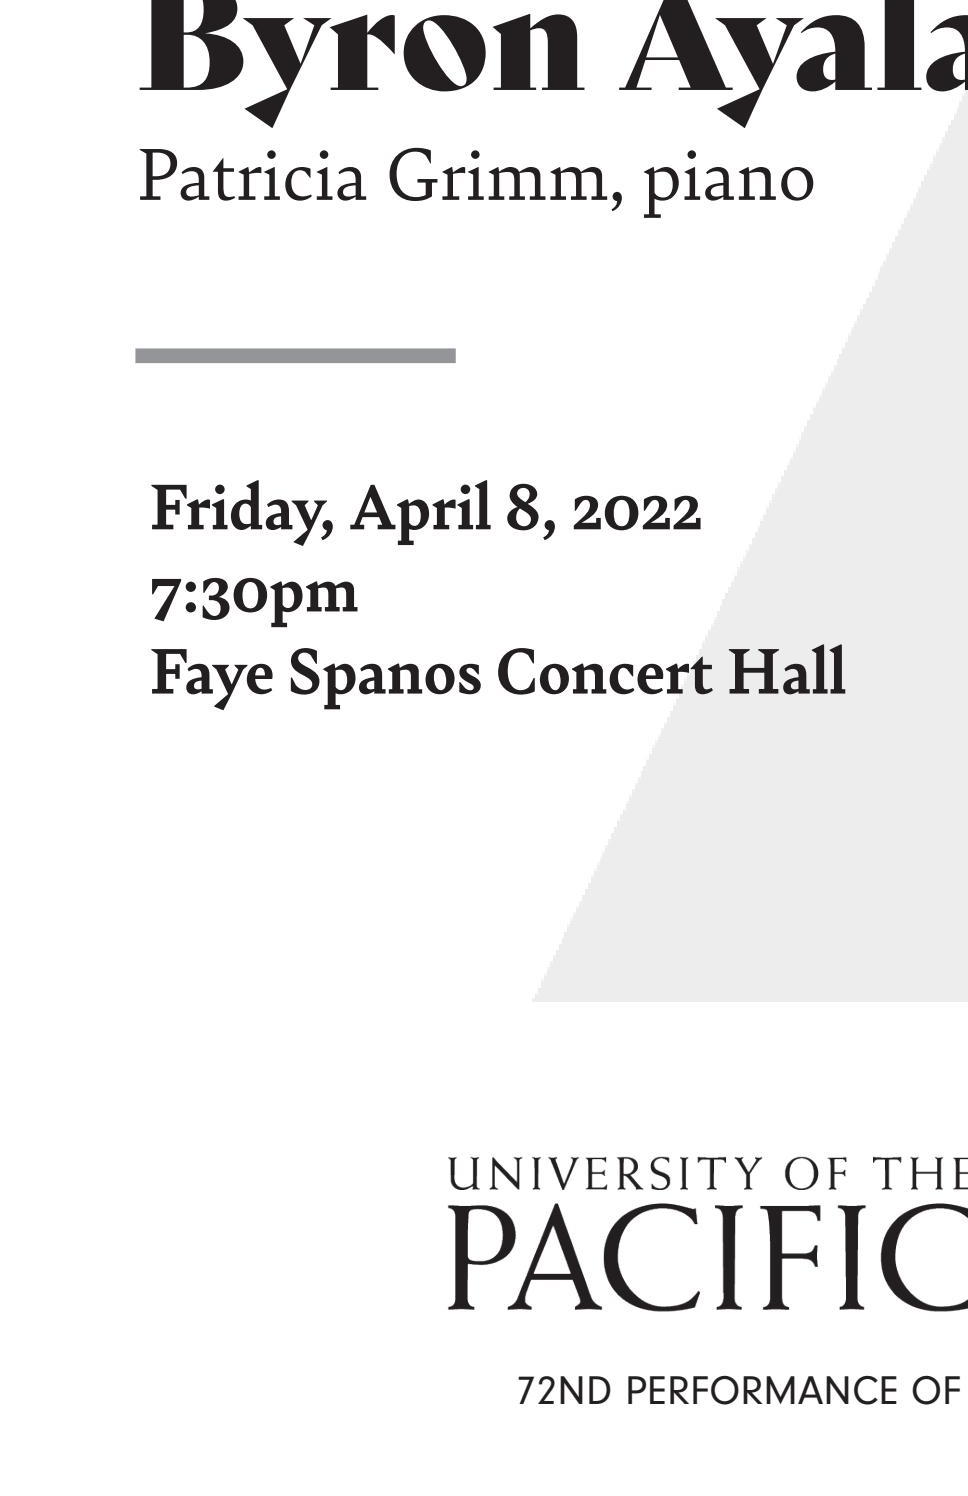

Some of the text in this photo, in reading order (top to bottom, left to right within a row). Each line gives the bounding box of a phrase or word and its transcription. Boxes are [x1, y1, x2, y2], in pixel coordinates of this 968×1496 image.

[140, 148, 813, 218] Patricia Grimm, piano
[151, 480, 701, 546] Friday, April 8, 2022
[152, 578, 358, 627] 7:30pm
[151, 644, 845, 710] Faye Spanos Concert Hall
[449, 1157, 762, 1190] UNIVERSITY
[785, 1157, 846, 1190] OF
[519, 1376, 610, 1404] 72ND
[628, 1376, 896, 1405] PERFORMANCE
[913, 1376, 960, 1405] OF
